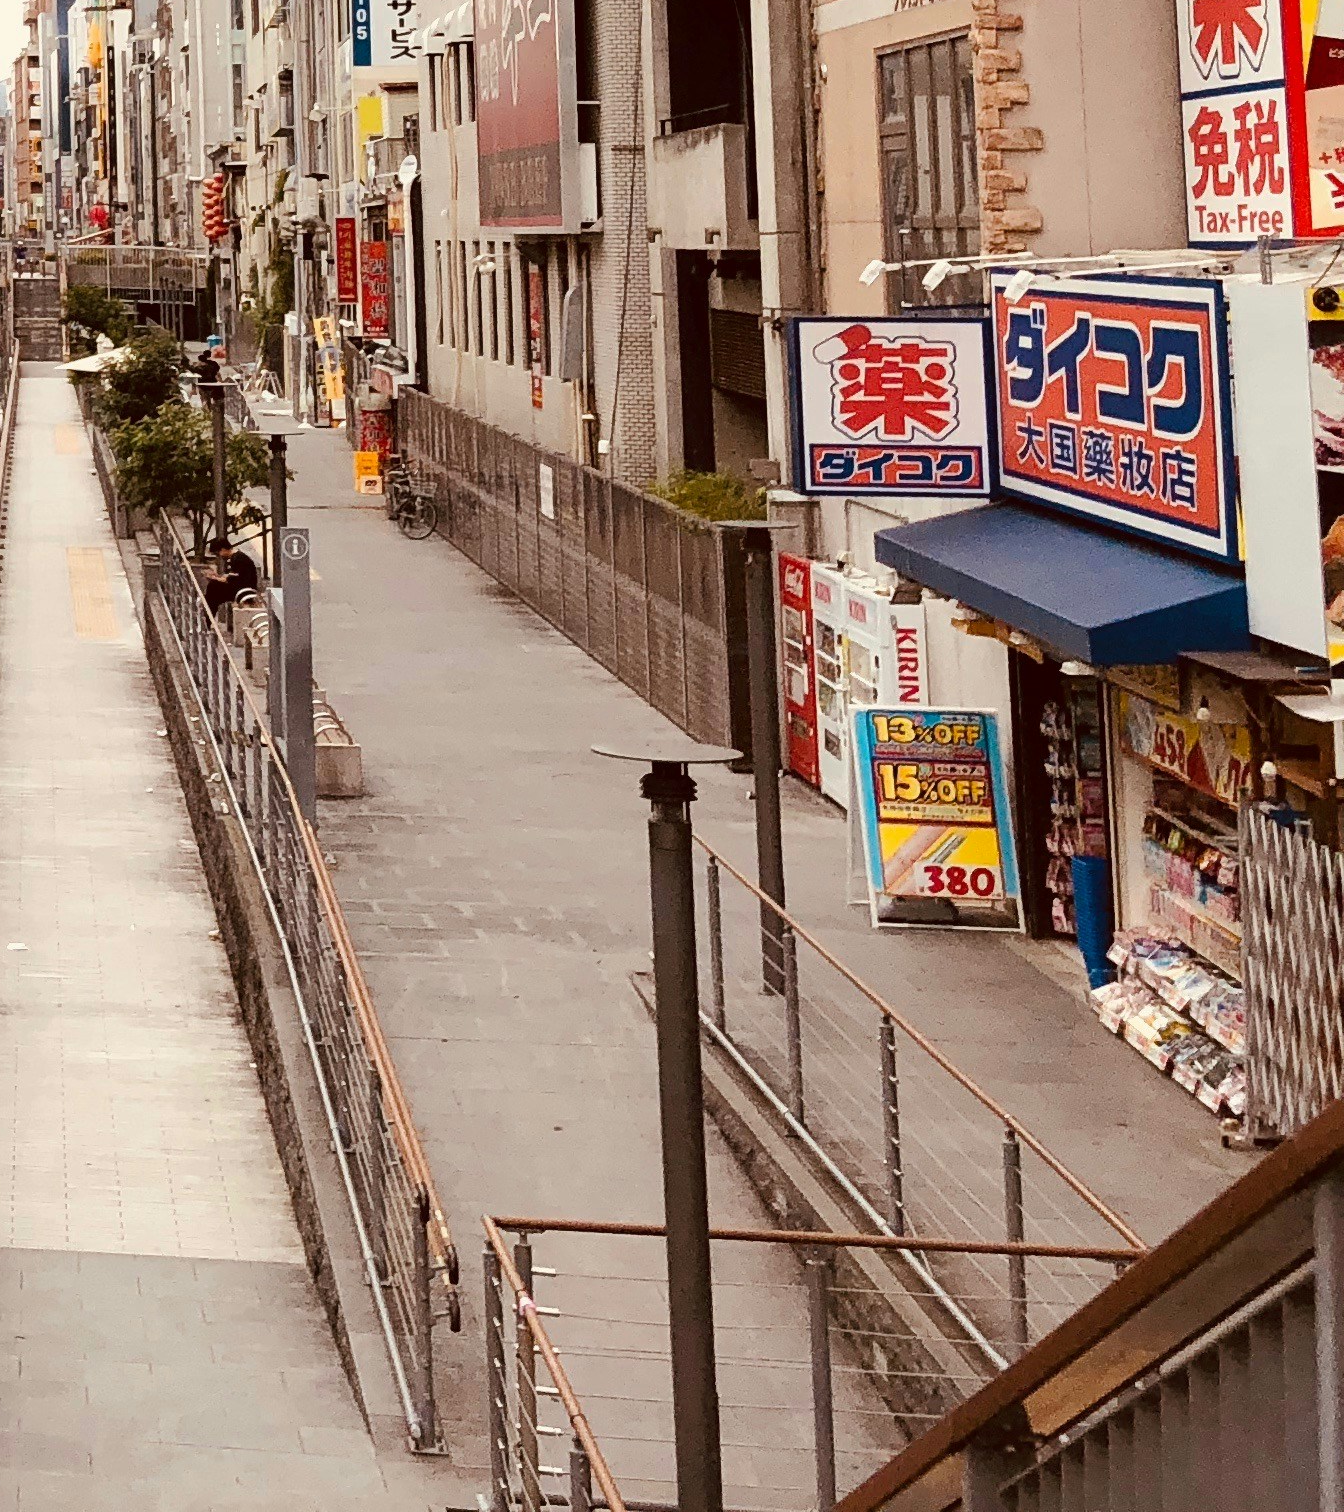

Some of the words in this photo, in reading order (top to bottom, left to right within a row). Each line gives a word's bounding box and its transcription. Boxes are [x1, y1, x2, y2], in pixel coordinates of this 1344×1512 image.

[1188, 99, 1284, 199] 免税
[1194, 204, 1284, 234] Tax-Free
[834, 341, 954, 439] 薬
[1003, 305, 1204, 437] ダイコク
[818, 450, 975, 483] ダイコク
[895, 627, 920, 704] KIRIN
[923, 865, 996, 897] 380
